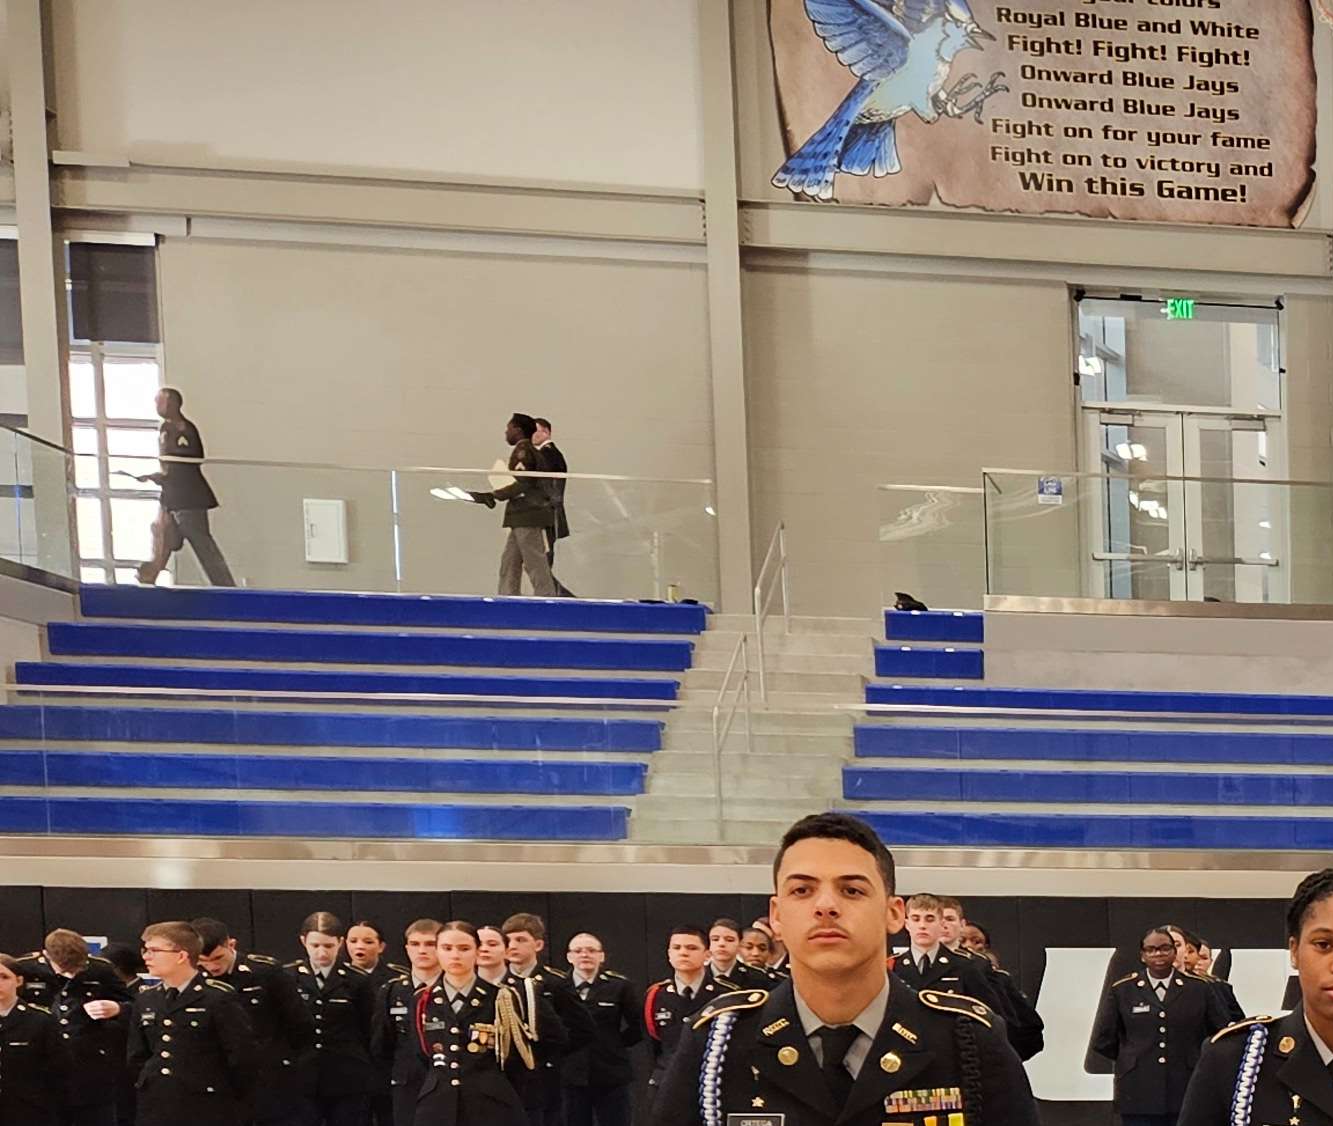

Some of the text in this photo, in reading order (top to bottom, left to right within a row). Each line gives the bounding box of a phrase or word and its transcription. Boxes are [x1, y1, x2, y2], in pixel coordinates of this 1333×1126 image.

[996, 6, 1261, 40] Royal Blue and White
[1007, 34, 1251, 68] Fight! Fight! Fight!
[1020, 64, 1240, 96] Onward Blue Jays
[1021, 92, 1241, 124] Onward Blue Jays
[991, 118, 1271, 150] Fight on for your fame
[990, 146, 1273, 178] Fight on to victory and
[1018, 171, 1248, 203] Win this Game!
[1167, 299, 1195, 320] EXIT
